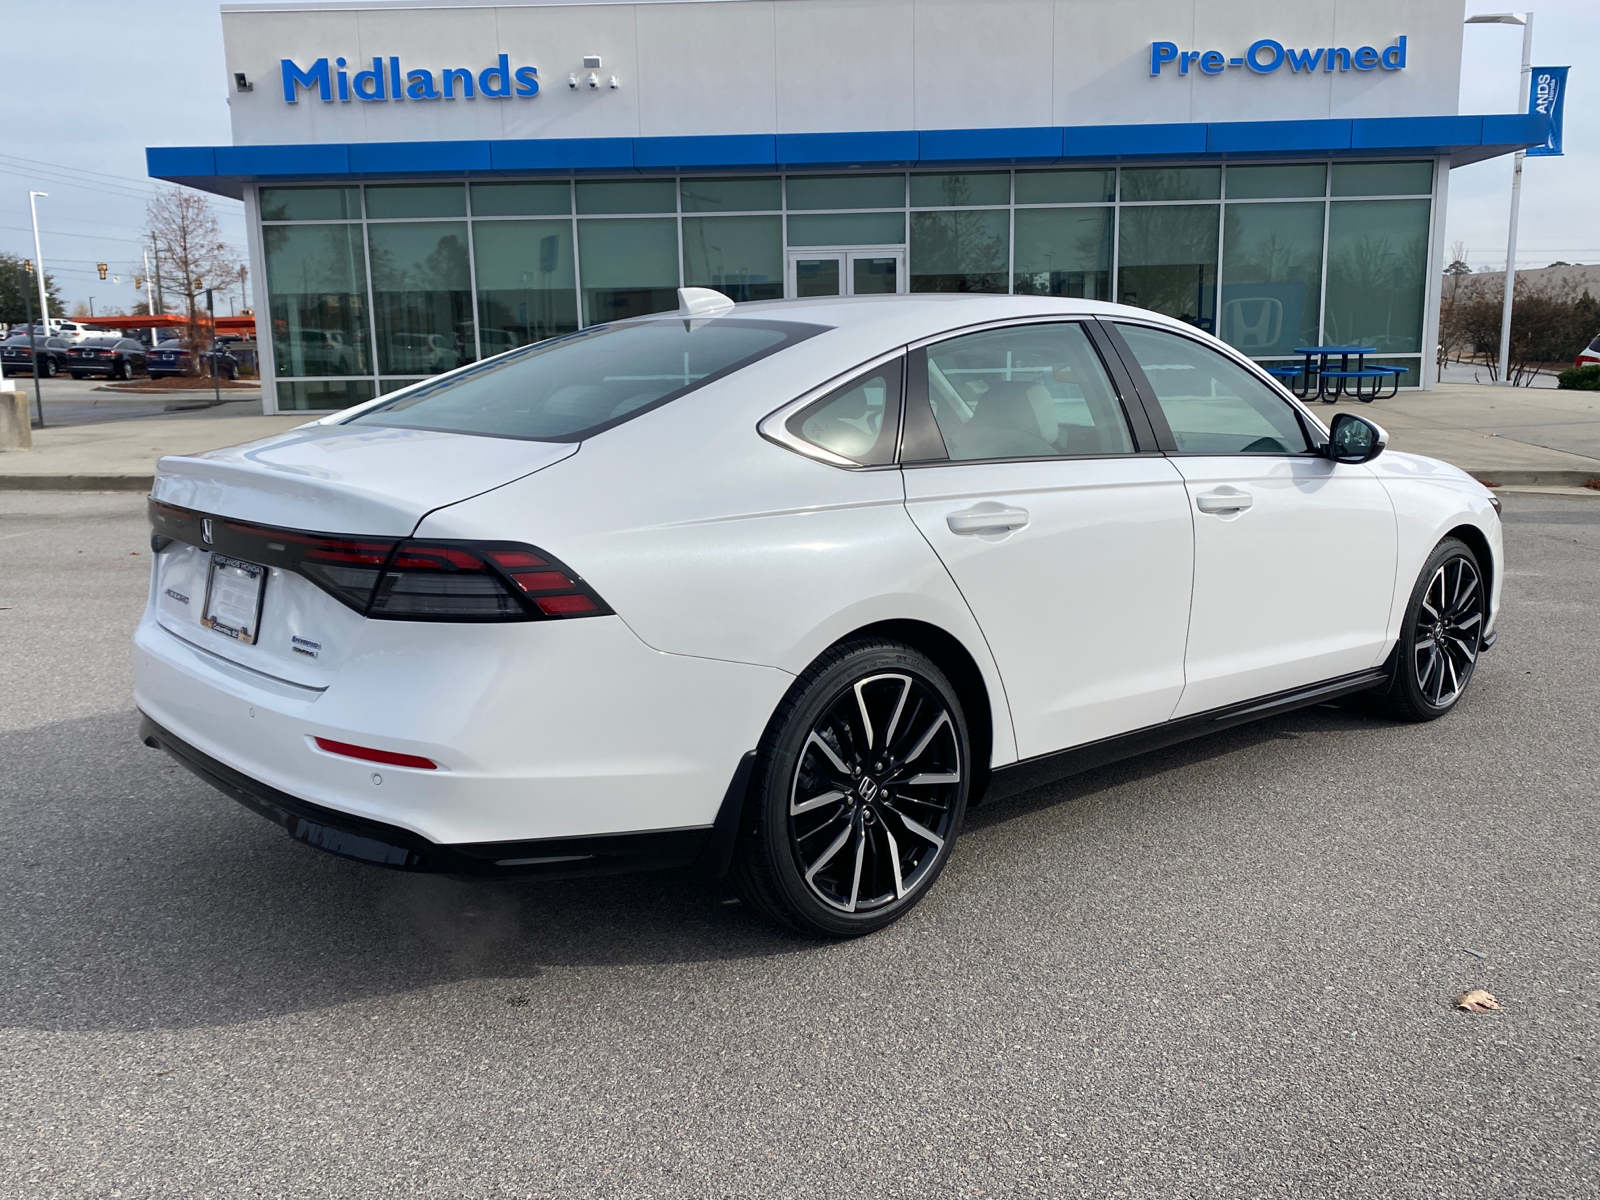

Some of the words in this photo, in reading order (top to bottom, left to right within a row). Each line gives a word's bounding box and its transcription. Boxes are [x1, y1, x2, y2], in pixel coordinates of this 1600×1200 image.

[1152, 36, 1406, 75] Pre-Owned
[281, 54, 538, 102] Midlands
[1548, 79, 1556, 101] Honda
[240, 561, 260, 573] HONDA
[295, 637, 319, 649] HYBRID
